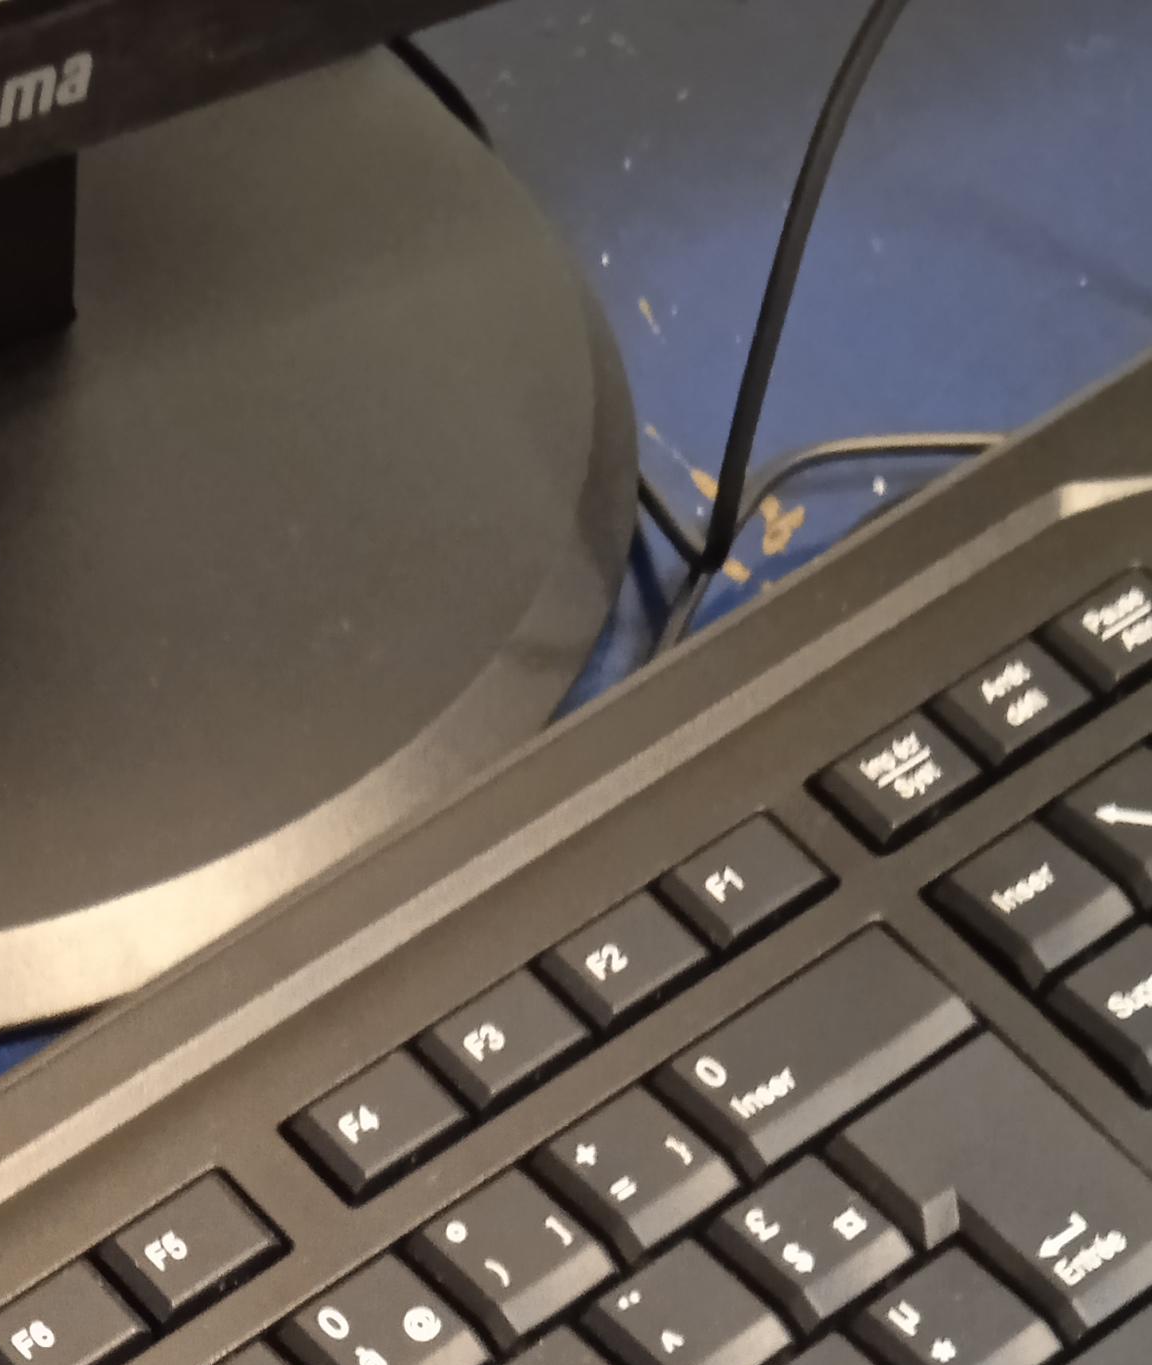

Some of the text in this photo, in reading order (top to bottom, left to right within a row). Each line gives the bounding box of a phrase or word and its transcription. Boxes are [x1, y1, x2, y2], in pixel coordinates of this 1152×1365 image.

[705, 866, 744, 903] F1
[585, 943, 628, 981] F2
[463, 1023, 506, 1062] F3
[694, 1056, 727, 1089] 0
[337, 1104, 380, 1145] F4
[144, 1229, 188, 1272] F5
[10, 1319, 56, 1361] F6
[317, 1306, 350, 1340] 0
[402, 1305, 443, 1343] @
